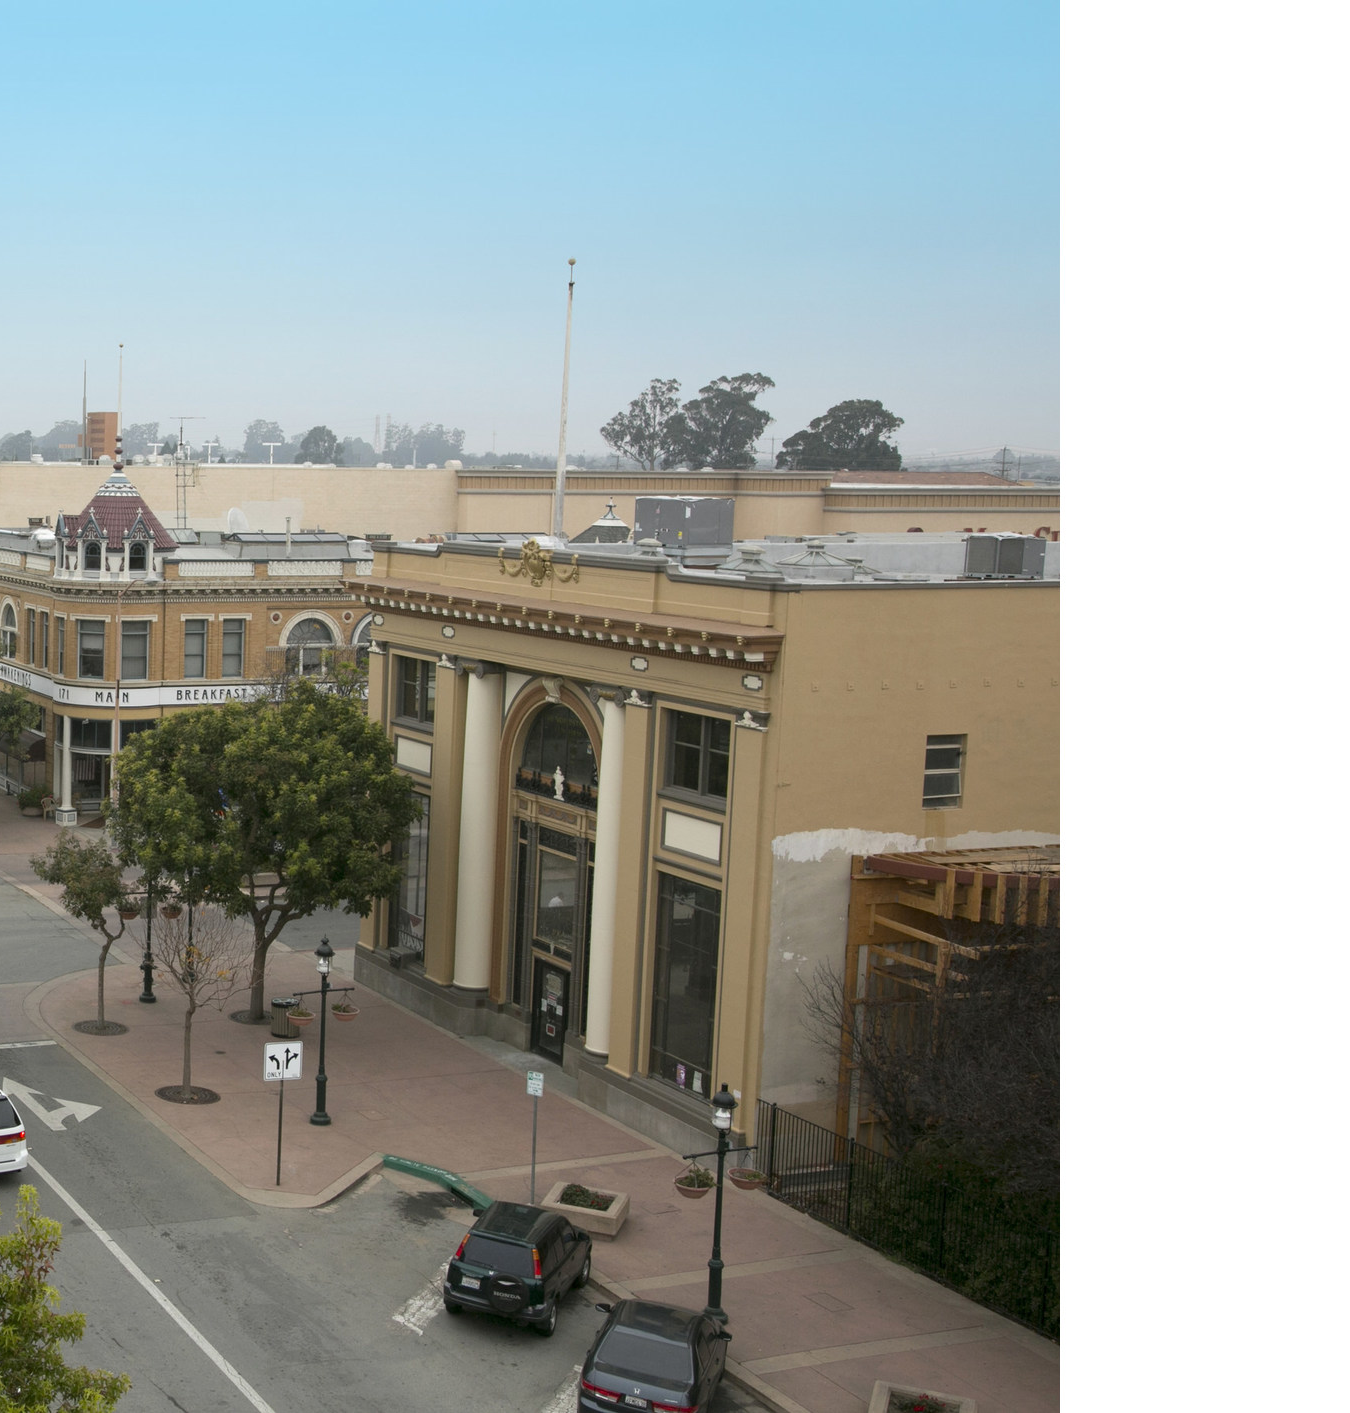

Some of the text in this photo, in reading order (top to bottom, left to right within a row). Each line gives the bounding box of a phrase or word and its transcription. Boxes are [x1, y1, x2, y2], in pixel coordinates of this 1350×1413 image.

[58, 688, 129, 703] 171 MAN
[176, 688, 248, 701] BREAKFAST
[493, 1290, 522, 1300] HONDA
